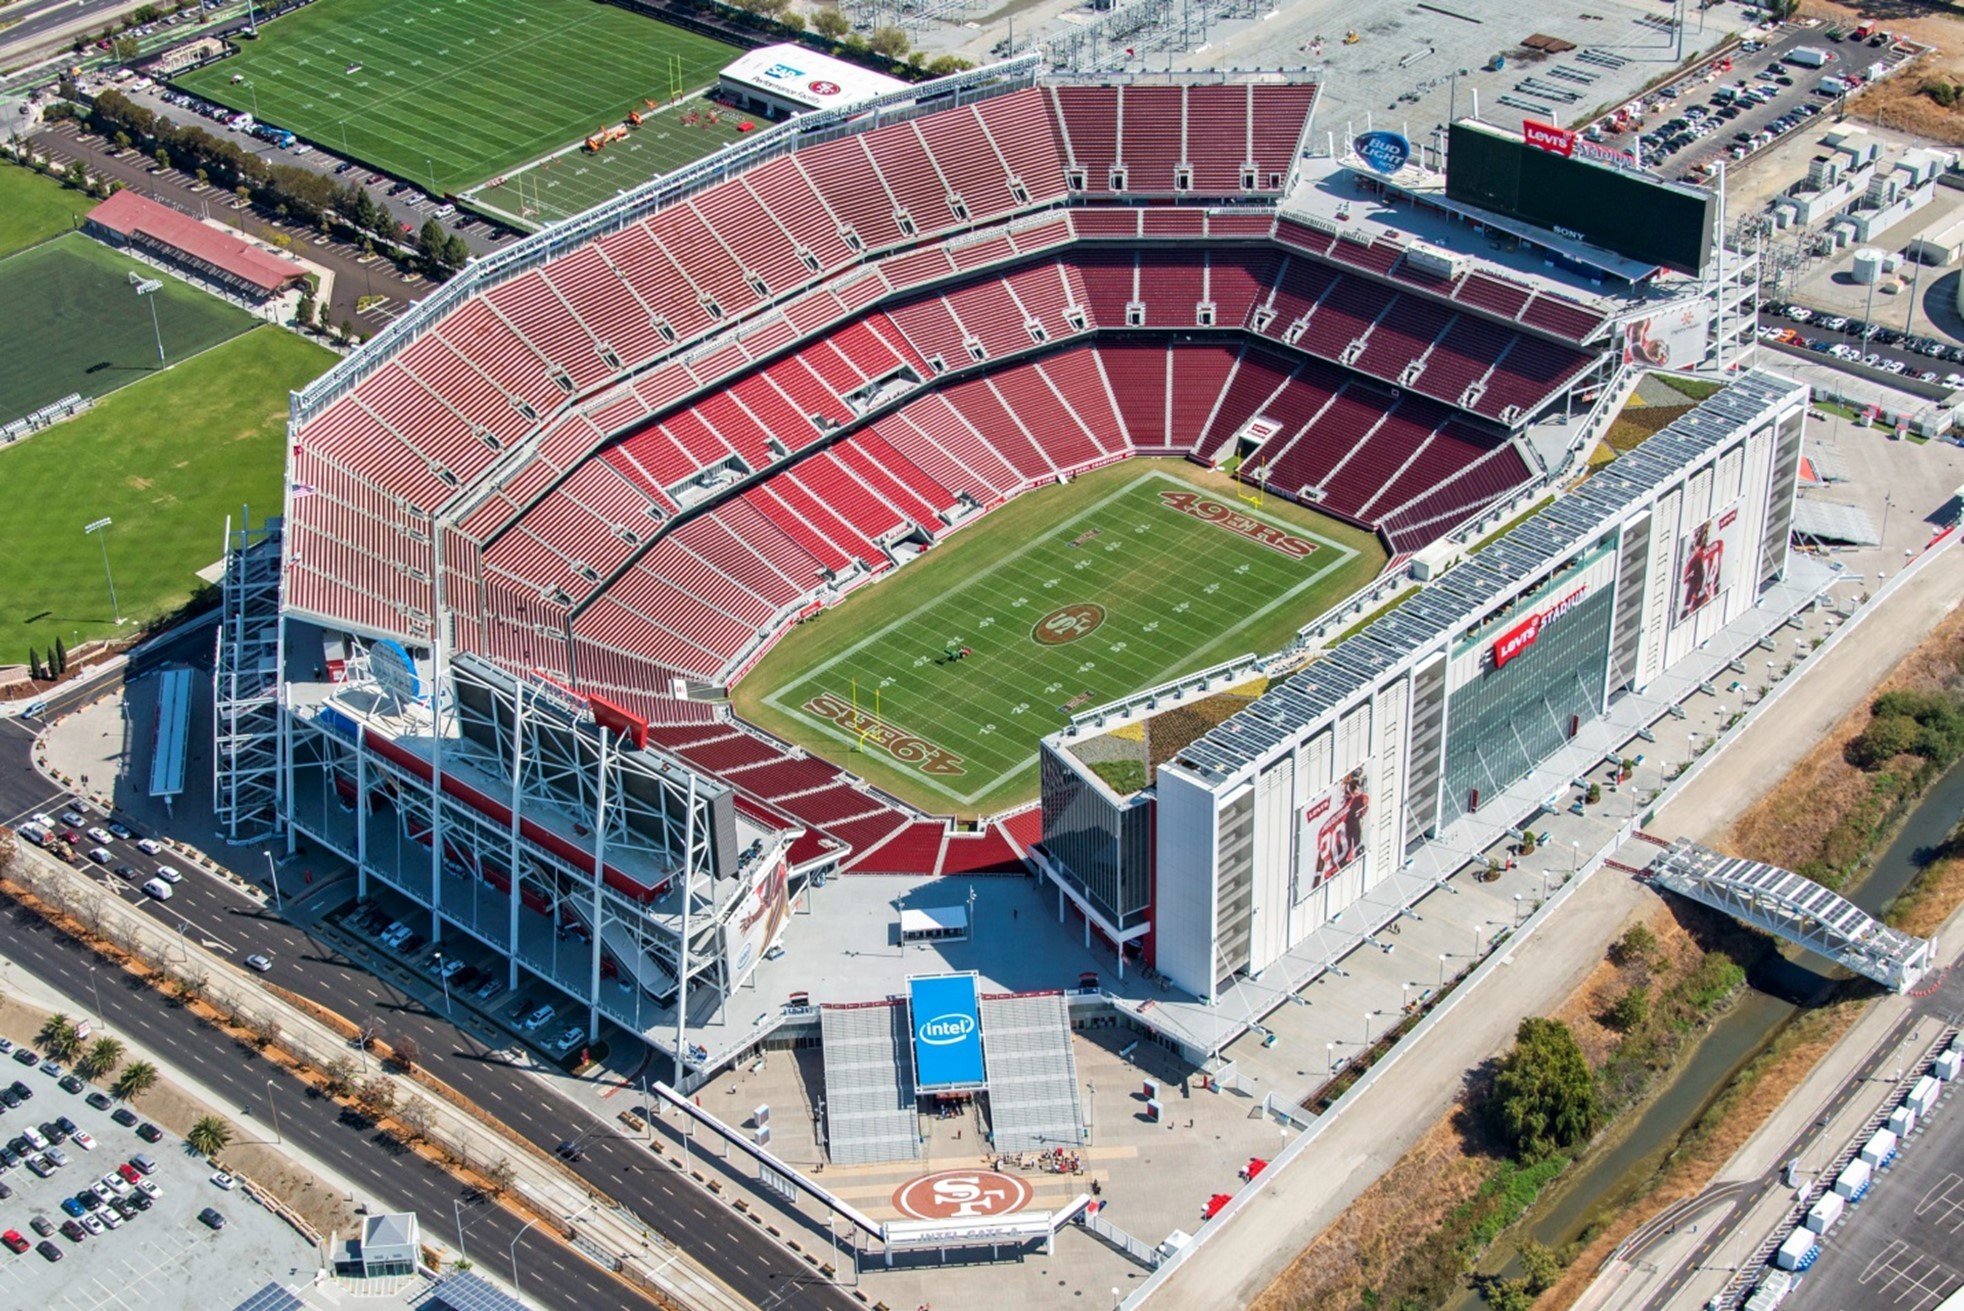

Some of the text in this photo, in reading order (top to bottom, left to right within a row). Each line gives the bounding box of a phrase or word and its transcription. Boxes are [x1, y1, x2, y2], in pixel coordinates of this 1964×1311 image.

[766, 64, 800, 80] SAP
[752, 75, 821, 104] Performance Facility
[1360, 144, 1405, 164] LIGHT
[1369, 138, 1401, 155] BUD
[1553, 225, 1585, 240] SONY
[1158, 491, 1320, 560] 49ERS
[1540, 583, 1590, 630] STADIUM
[1045, 611, 1092, 635] SF
[1109, 641, 1127, 653] 50
[802, 692, 968, 776] 49ERS
[926, 1019, 966, 1036] intel
[933, 1176, 1005, 1218] SF
[919, 1230, 958, 1243] INTEL
